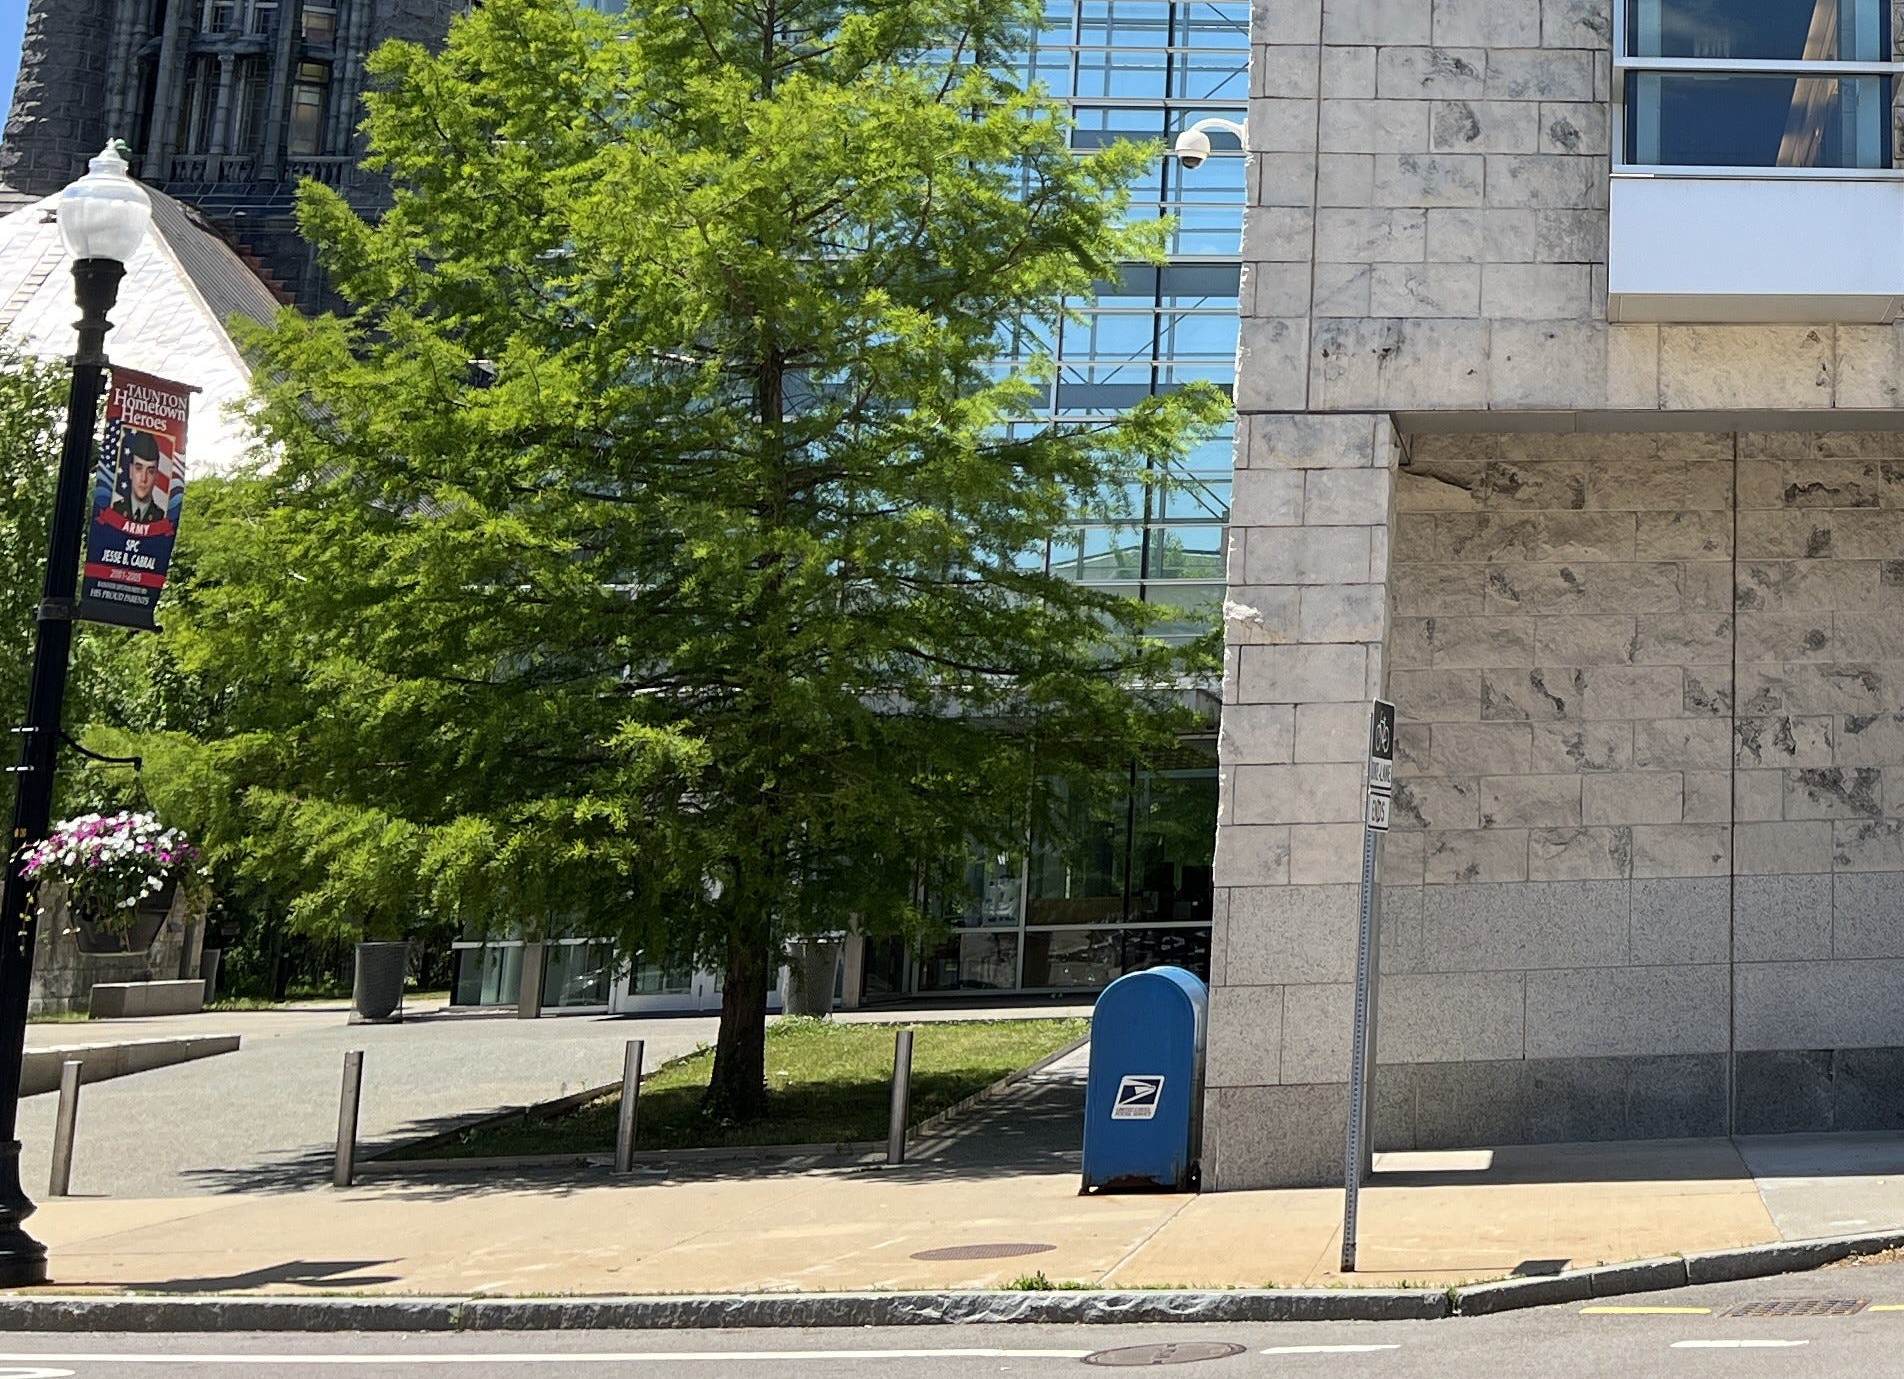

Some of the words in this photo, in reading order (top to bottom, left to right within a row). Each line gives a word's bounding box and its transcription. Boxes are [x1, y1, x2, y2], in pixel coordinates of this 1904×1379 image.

[113, 388, 186, 421] Hometown
[127, 383, 187, 409] TAUNTON
[120, 405, 168, 431] Heroes
[122, 521, 150, 536] ARMY
[125, 539, 140, 552] SPC
